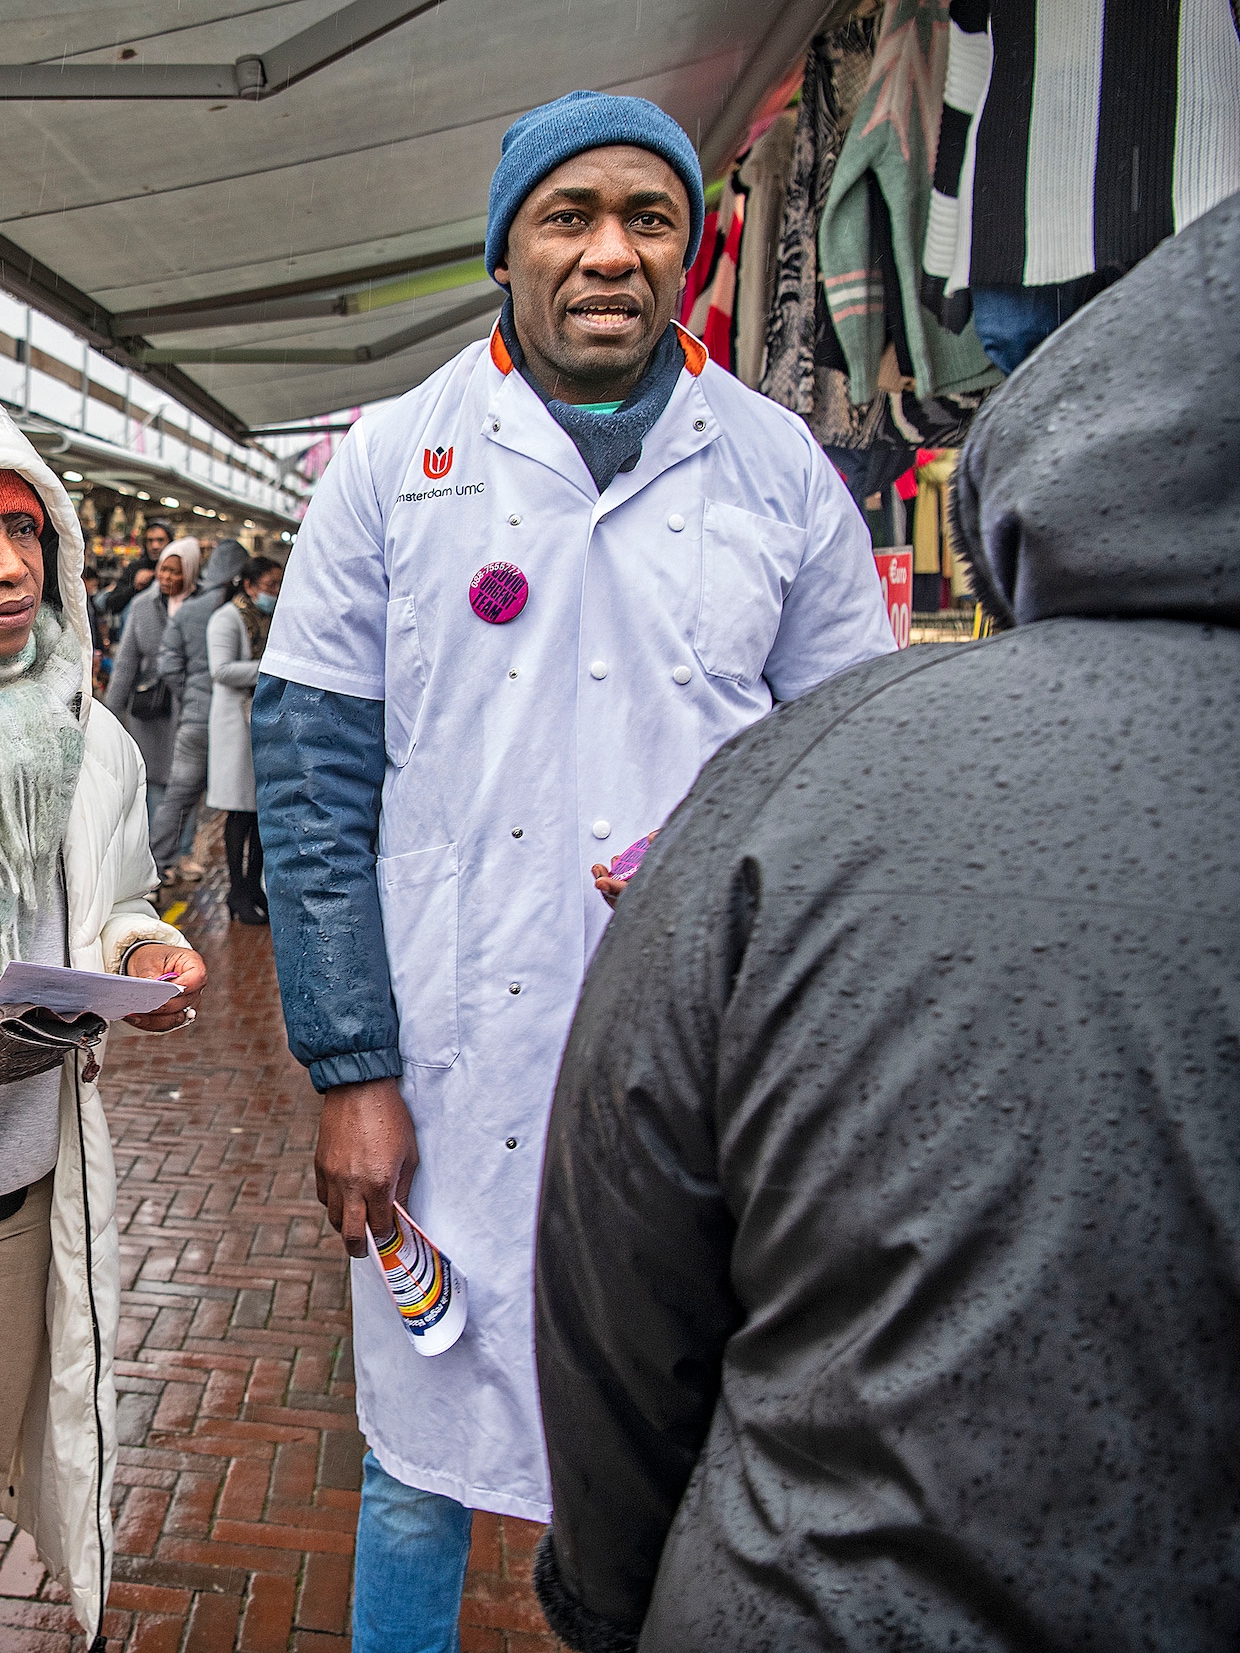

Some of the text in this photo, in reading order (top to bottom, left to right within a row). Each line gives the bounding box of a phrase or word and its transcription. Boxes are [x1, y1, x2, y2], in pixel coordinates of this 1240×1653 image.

[396, 488, 452, 503] msterdam
[471, 591, 503, 622] TEAM
[479, 576, 517, 610] URGENT
